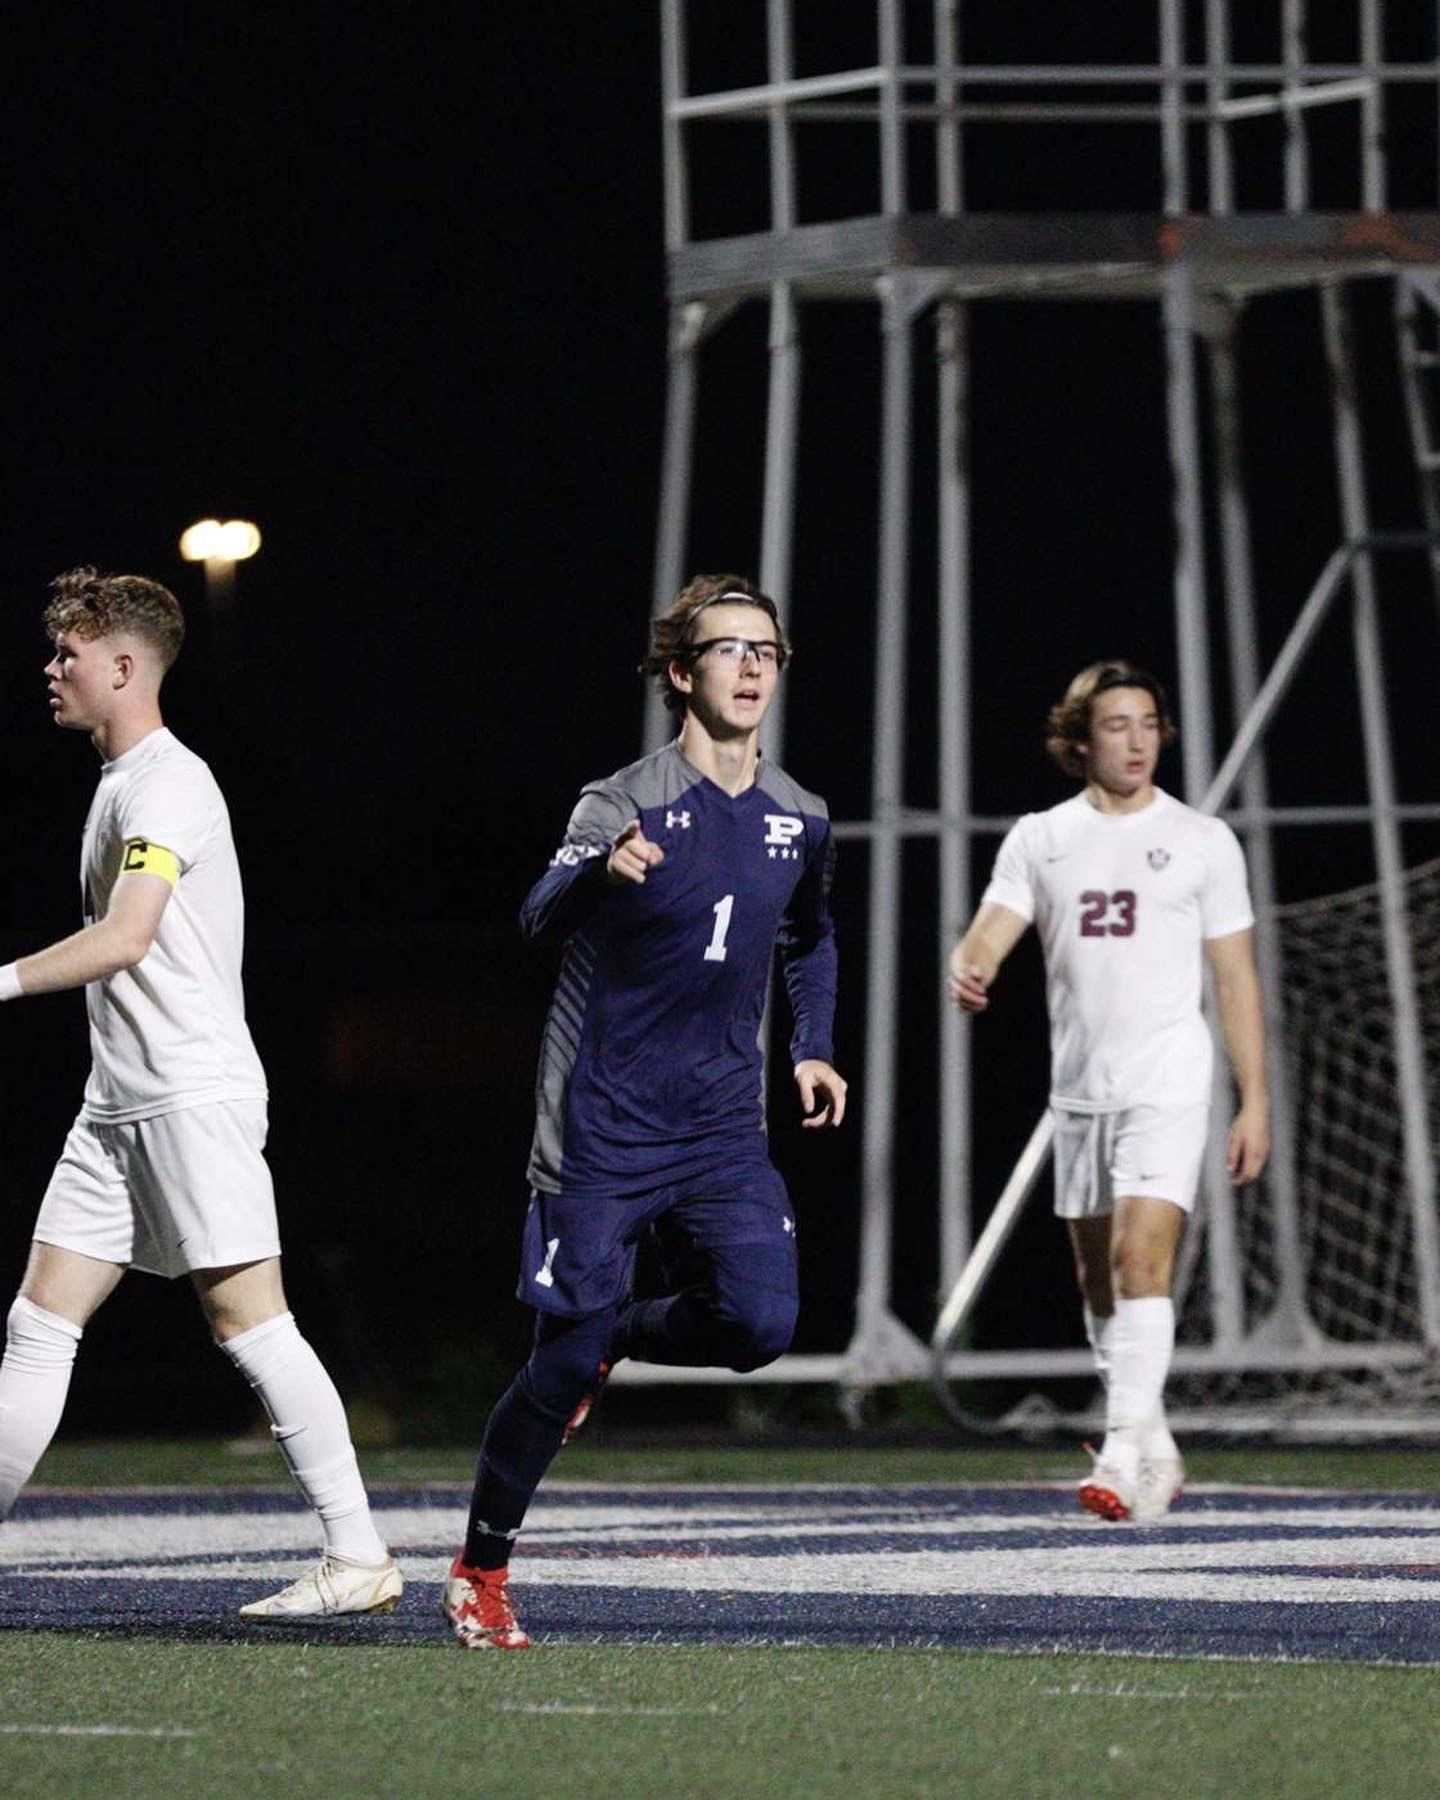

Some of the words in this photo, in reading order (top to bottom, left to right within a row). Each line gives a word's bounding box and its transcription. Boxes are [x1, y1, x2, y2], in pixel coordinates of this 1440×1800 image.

[764, 814, 804, 845] P
[123, 842, 147, 870] C
[704, 894, 734, 961] 1
[1079, 889, 1137, 937] 23
[534, 1238, 559, 1288] 1
